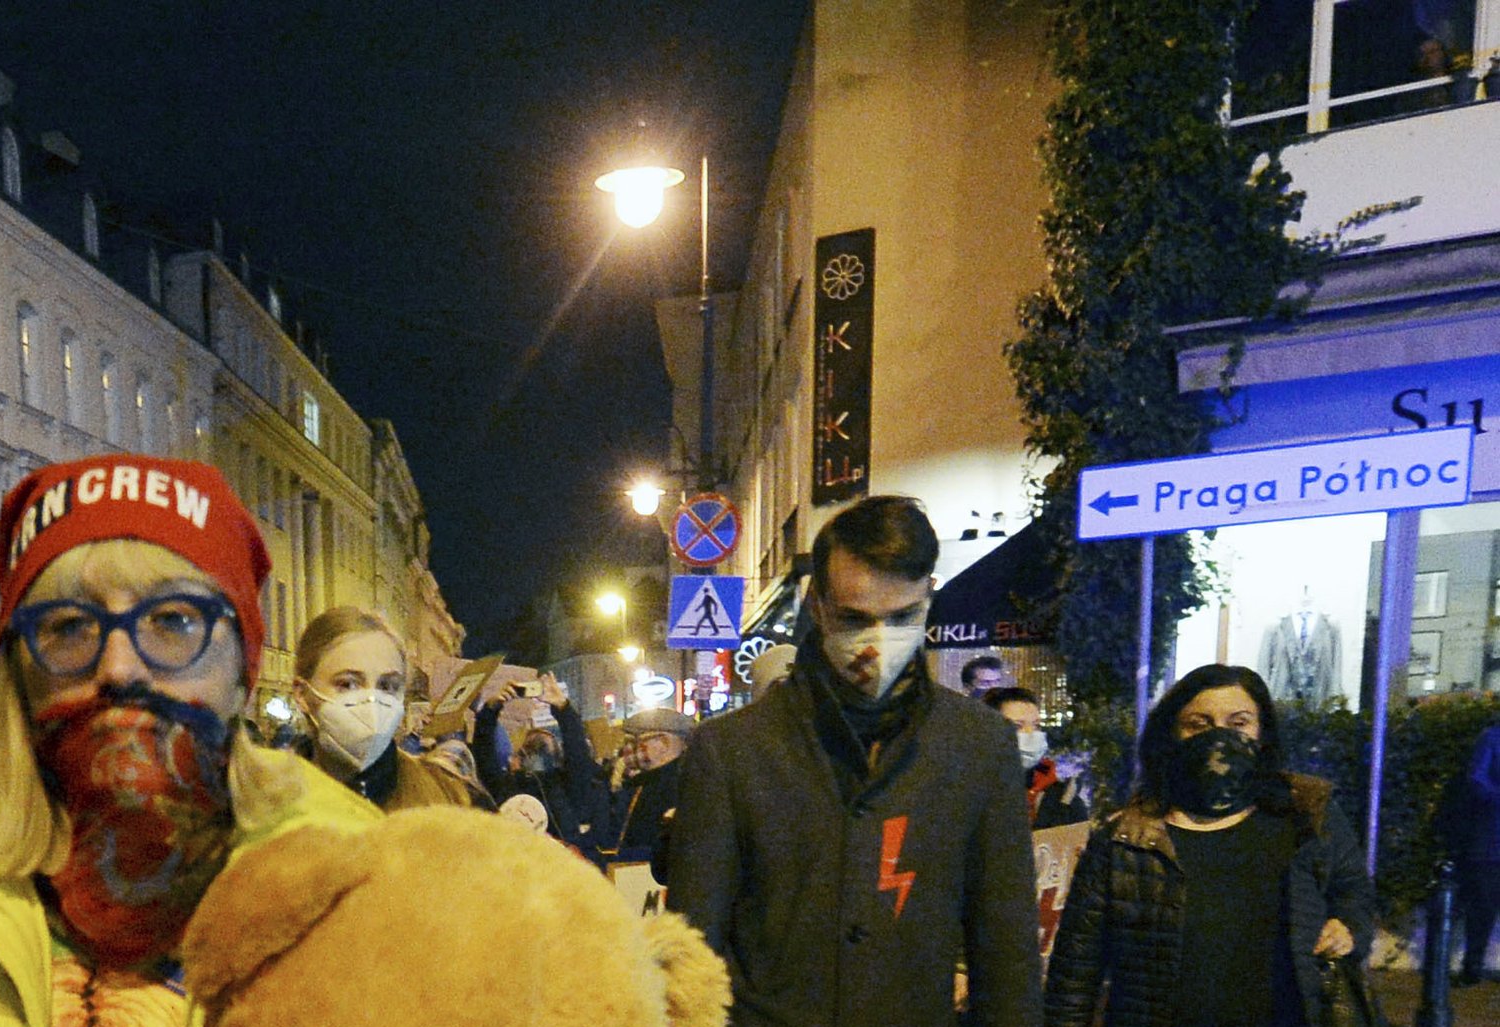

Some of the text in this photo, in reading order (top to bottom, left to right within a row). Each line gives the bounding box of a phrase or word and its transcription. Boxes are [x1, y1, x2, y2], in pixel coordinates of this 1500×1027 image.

[77, 465, 210, 530] CREW
[1154, 459, 1460, 515] Praga Północ
